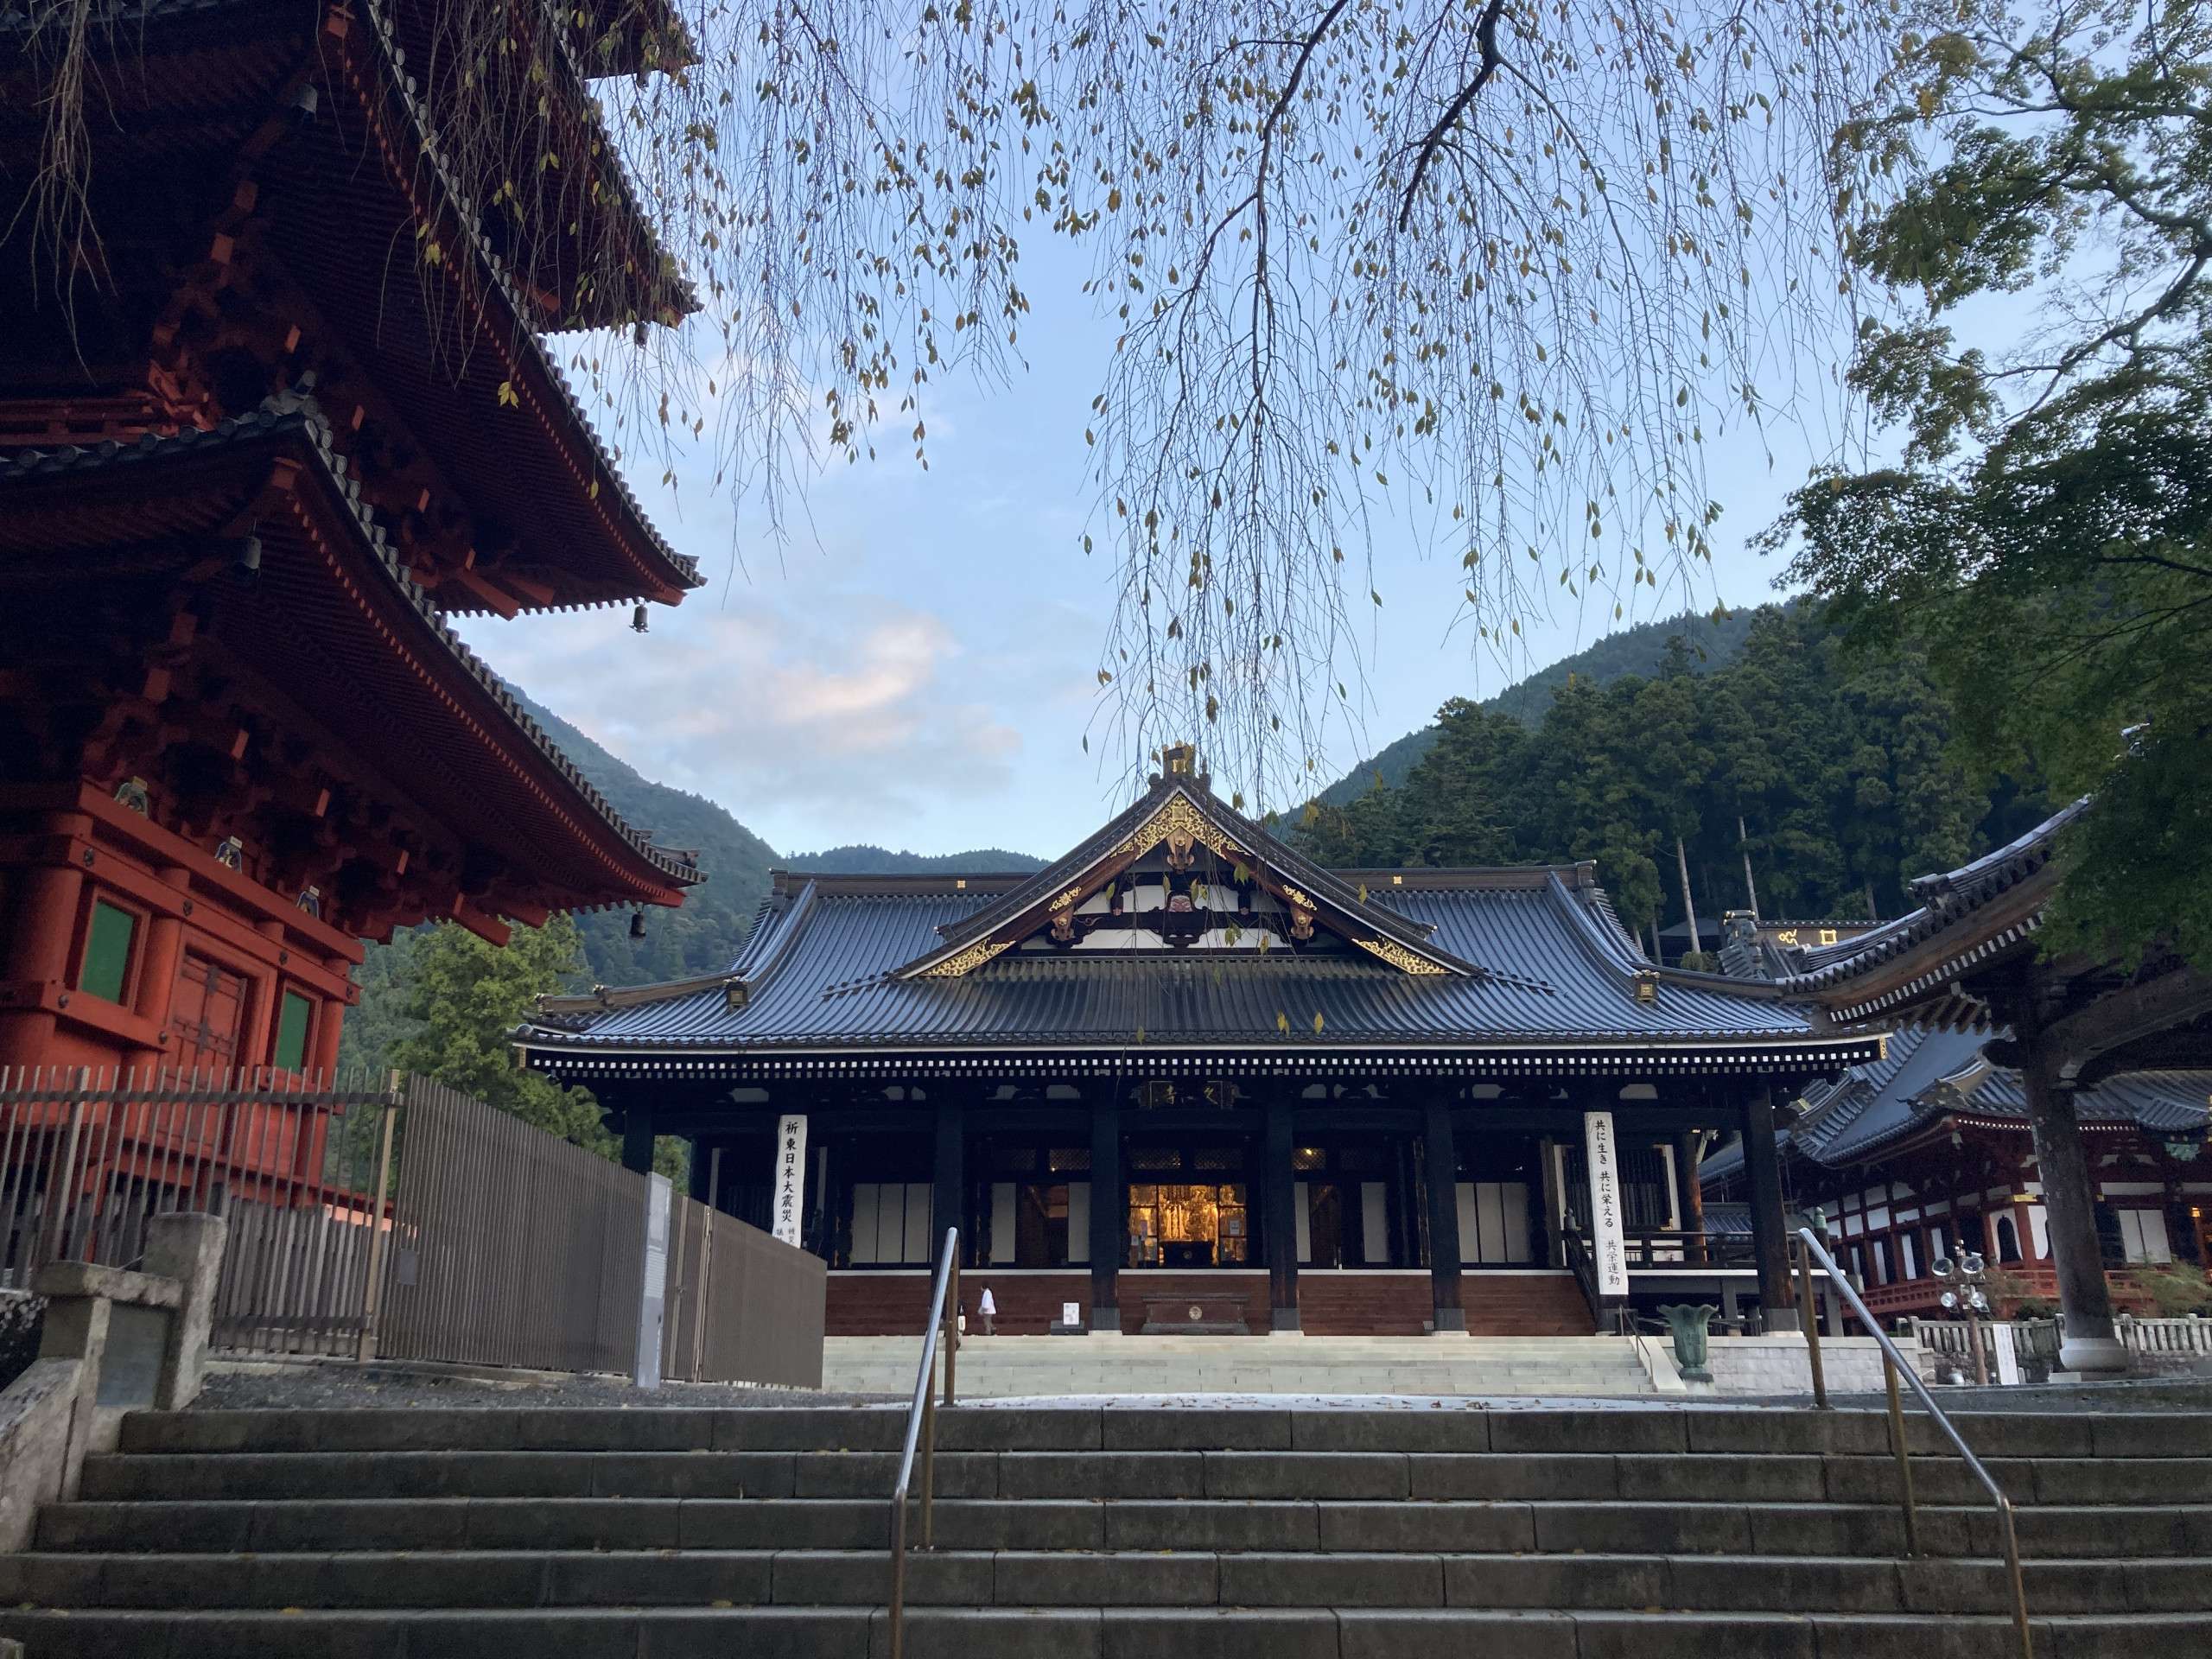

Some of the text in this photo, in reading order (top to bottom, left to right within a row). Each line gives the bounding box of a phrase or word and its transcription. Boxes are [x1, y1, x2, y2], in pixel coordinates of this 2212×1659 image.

[1163, 1084, 1218, 1105] 久寺
[1595, 1119, 1608, 1165] 共に生き
[781, 1122, 798, 1223] 祈東日本大震災
[1600, 1171, 1613, 1228] 共に栄える
